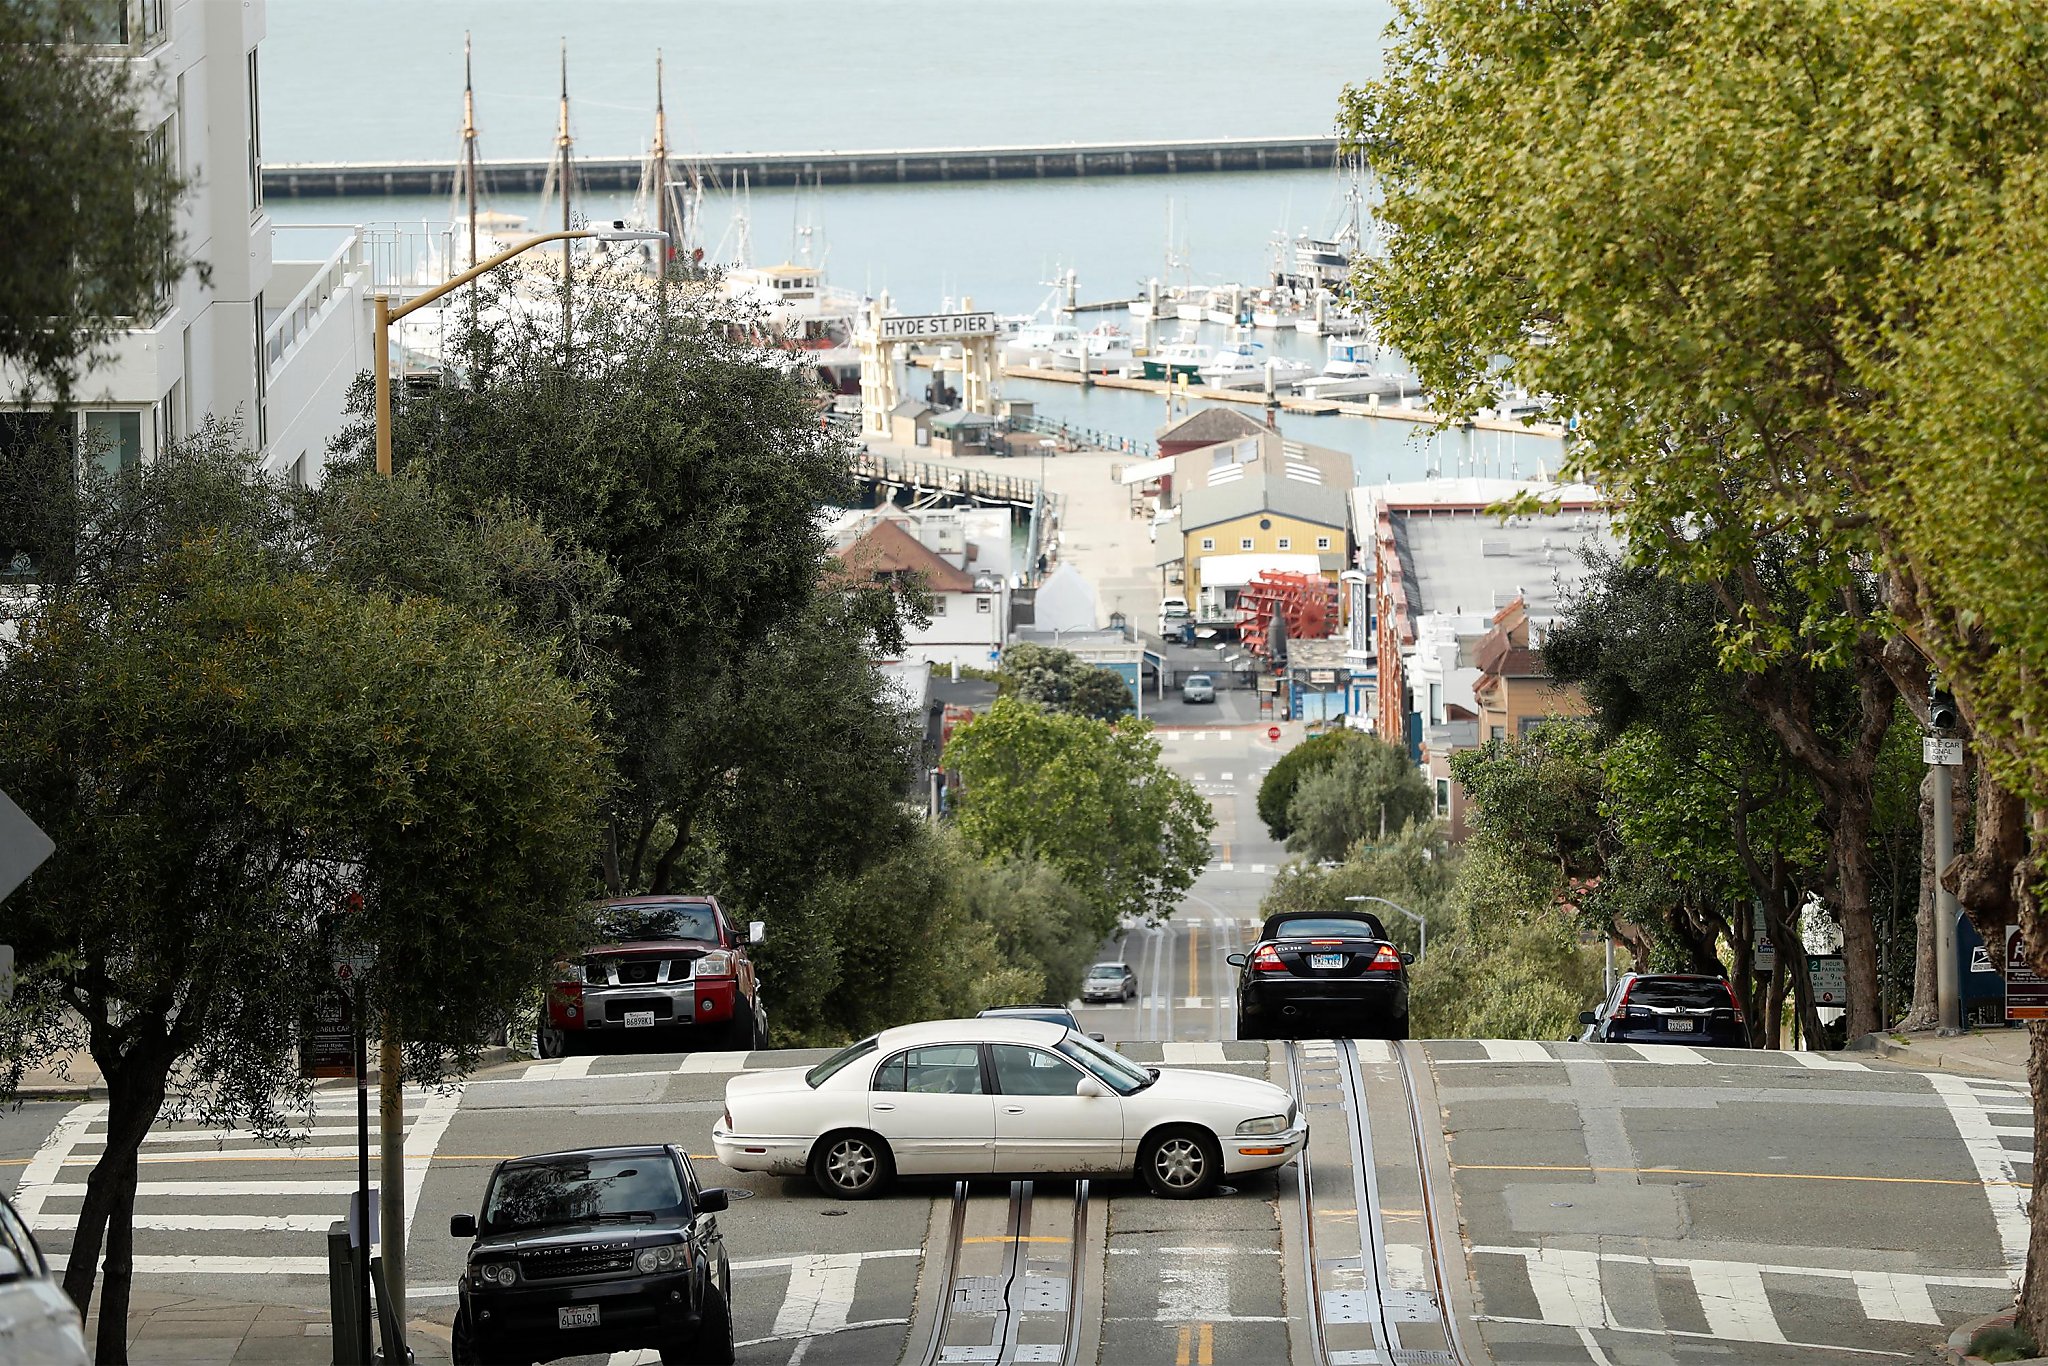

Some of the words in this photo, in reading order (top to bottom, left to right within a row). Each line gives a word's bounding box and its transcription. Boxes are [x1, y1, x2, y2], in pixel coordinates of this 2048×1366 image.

[885, 320, 925, 336] HYDE
[953, 316, 987, 332] PIER
[1811, 960, 1819, 971] 2
[523, 1248, 571, 1257] RANGE
[581, 1242, 629, 1252] ROVER
